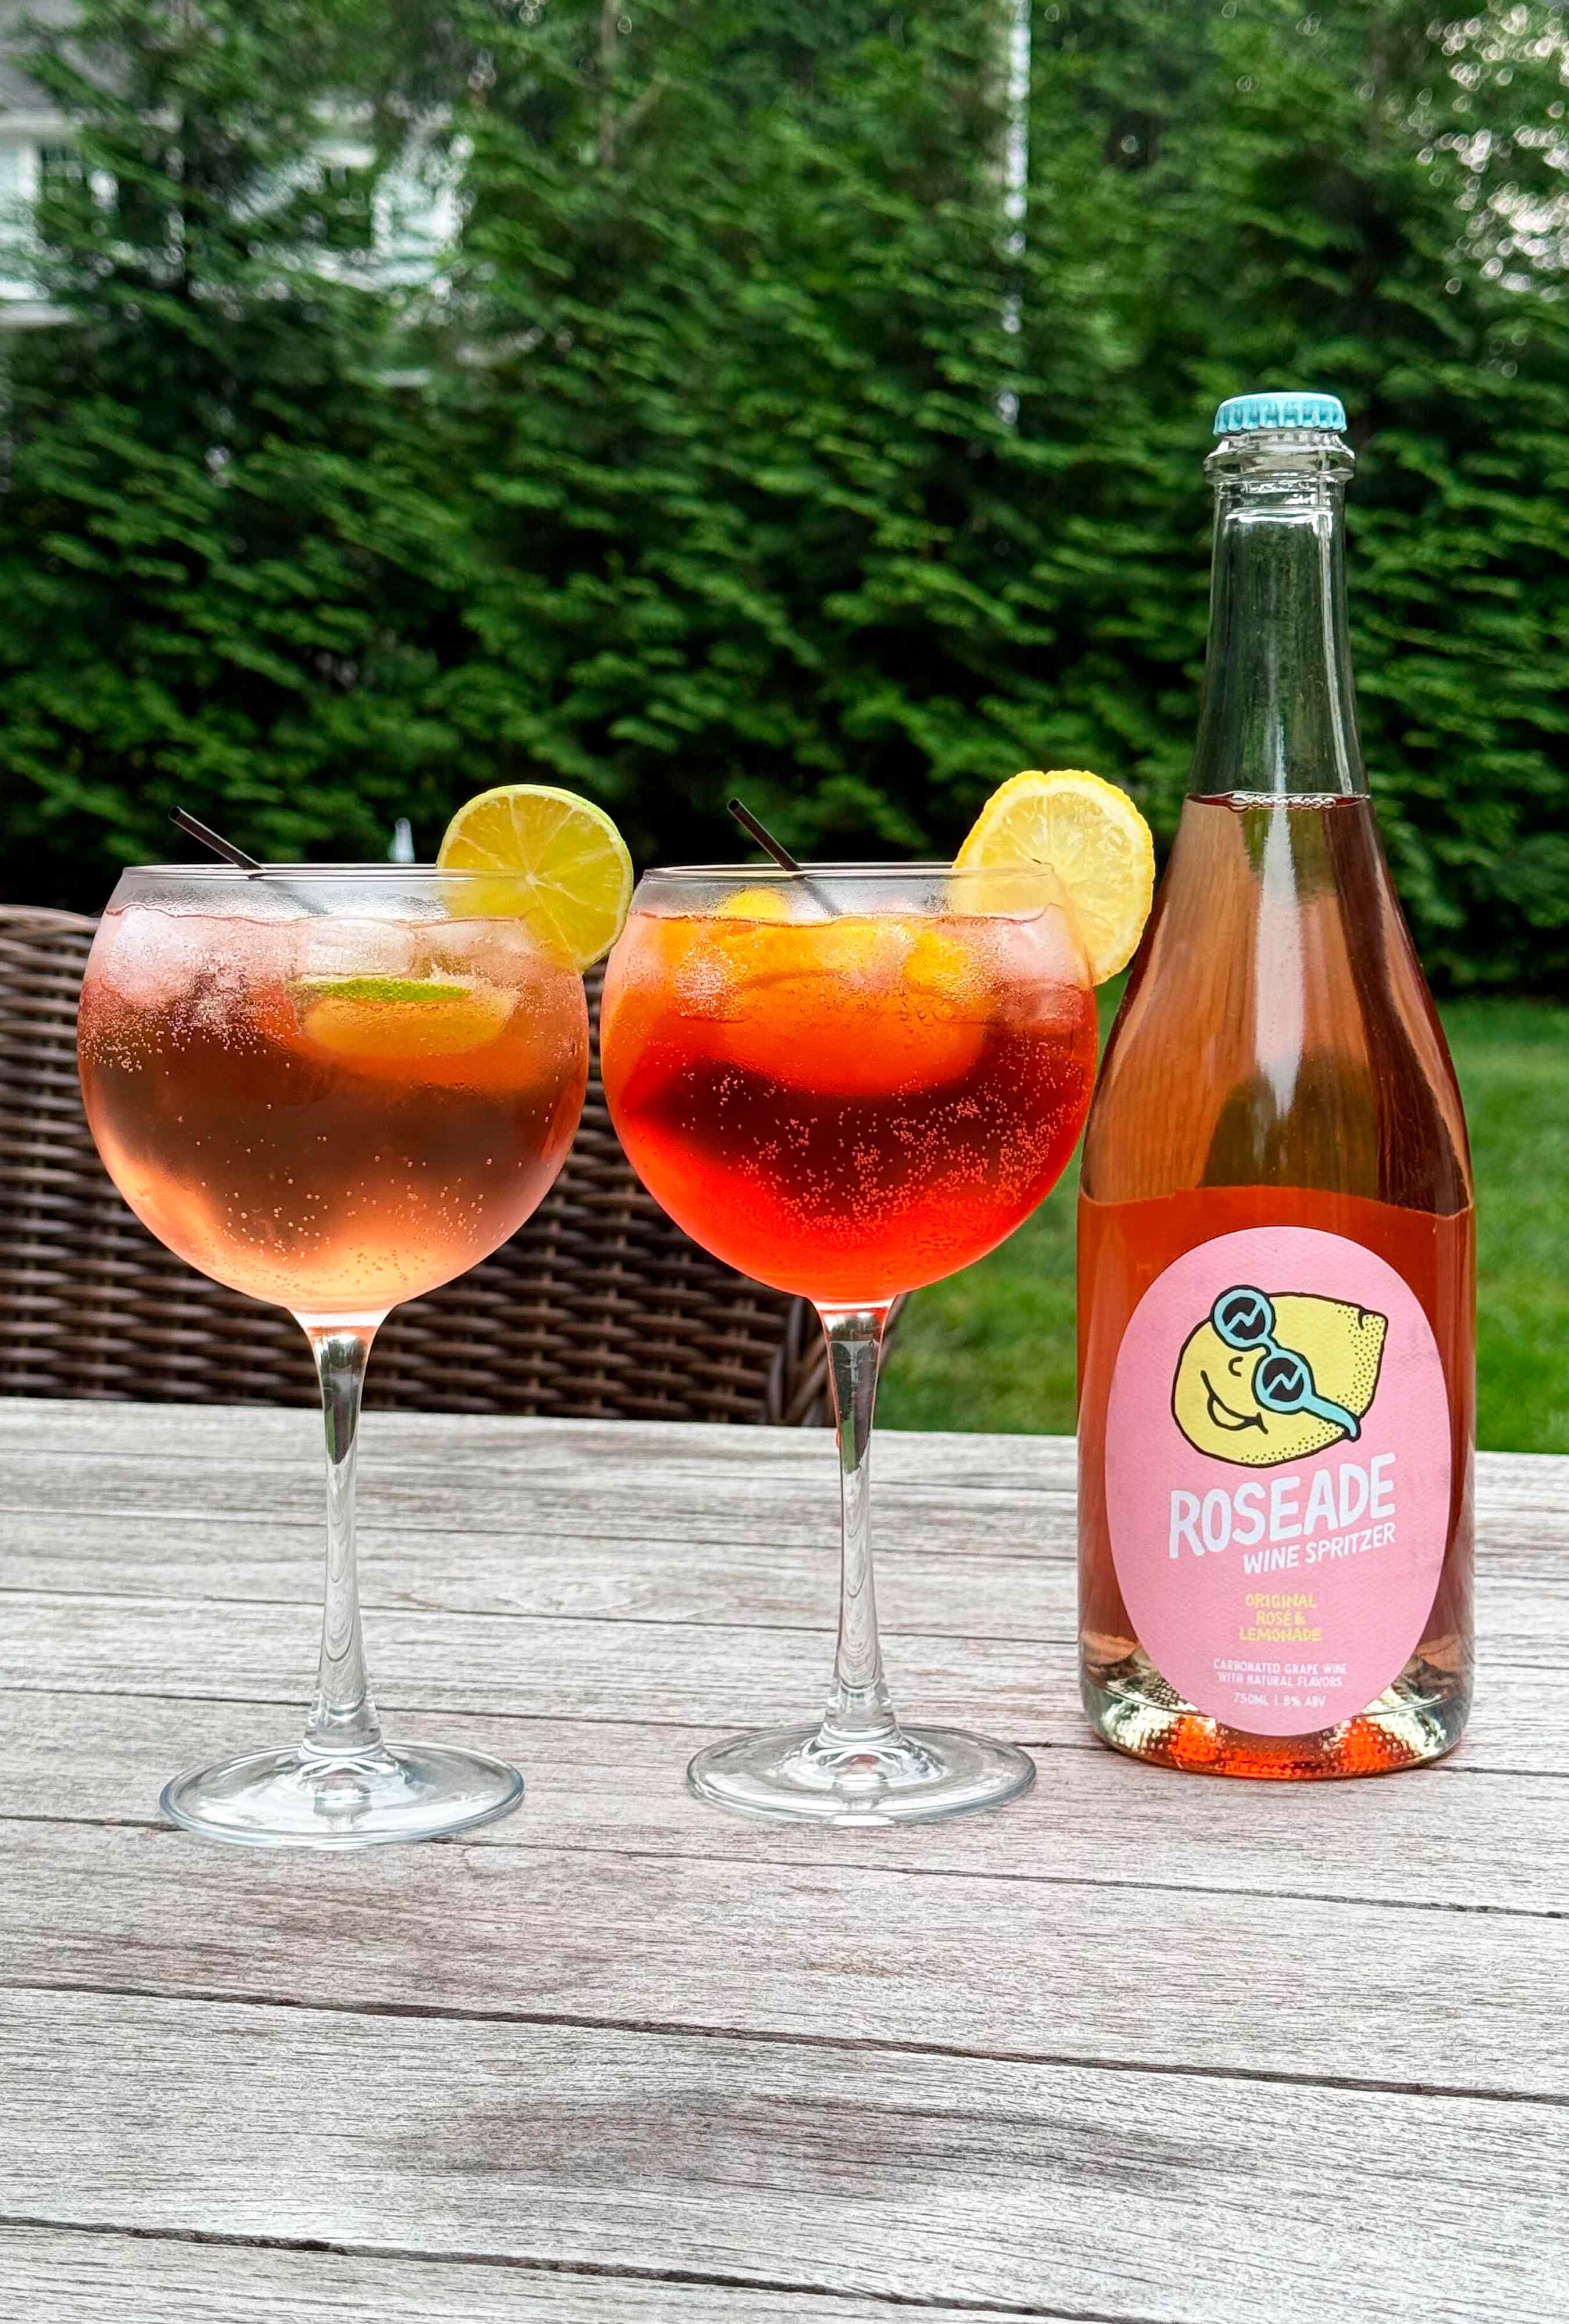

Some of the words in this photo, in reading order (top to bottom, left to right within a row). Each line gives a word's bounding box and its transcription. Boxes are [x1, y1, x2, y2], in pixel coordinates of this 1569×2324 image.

[1169, 1452, 1395, 1559] ROSEADE
[1242, 1543, 1300, 1575] WINE
[1305, 1522, 1395, 1563] SPRITZER
[1245, 1593, 1317, 1609] ORIGINAL
[1255, 1609, 1293, 1626] ROSÉ
[1295, 1611, 1306, 1625] &
[1239, 1626, 1321, 1642] LEMONADE
[1213, 1659, 1280, 1674] CARBONATED
[1284, 1663, 1318, 1674] GRAPE
[1322, 1663, 1347, 1674] WINE
[1218, 1672, 1243, 1683] WITH
[1246, 1674, 1294, 1687] NATURAL
[1298, 1676, 1342, 1687] FLAVORS
[1233, 1691, 1269, 1706] 750ML
[1304, 1695, 1326, 1706] ABV
